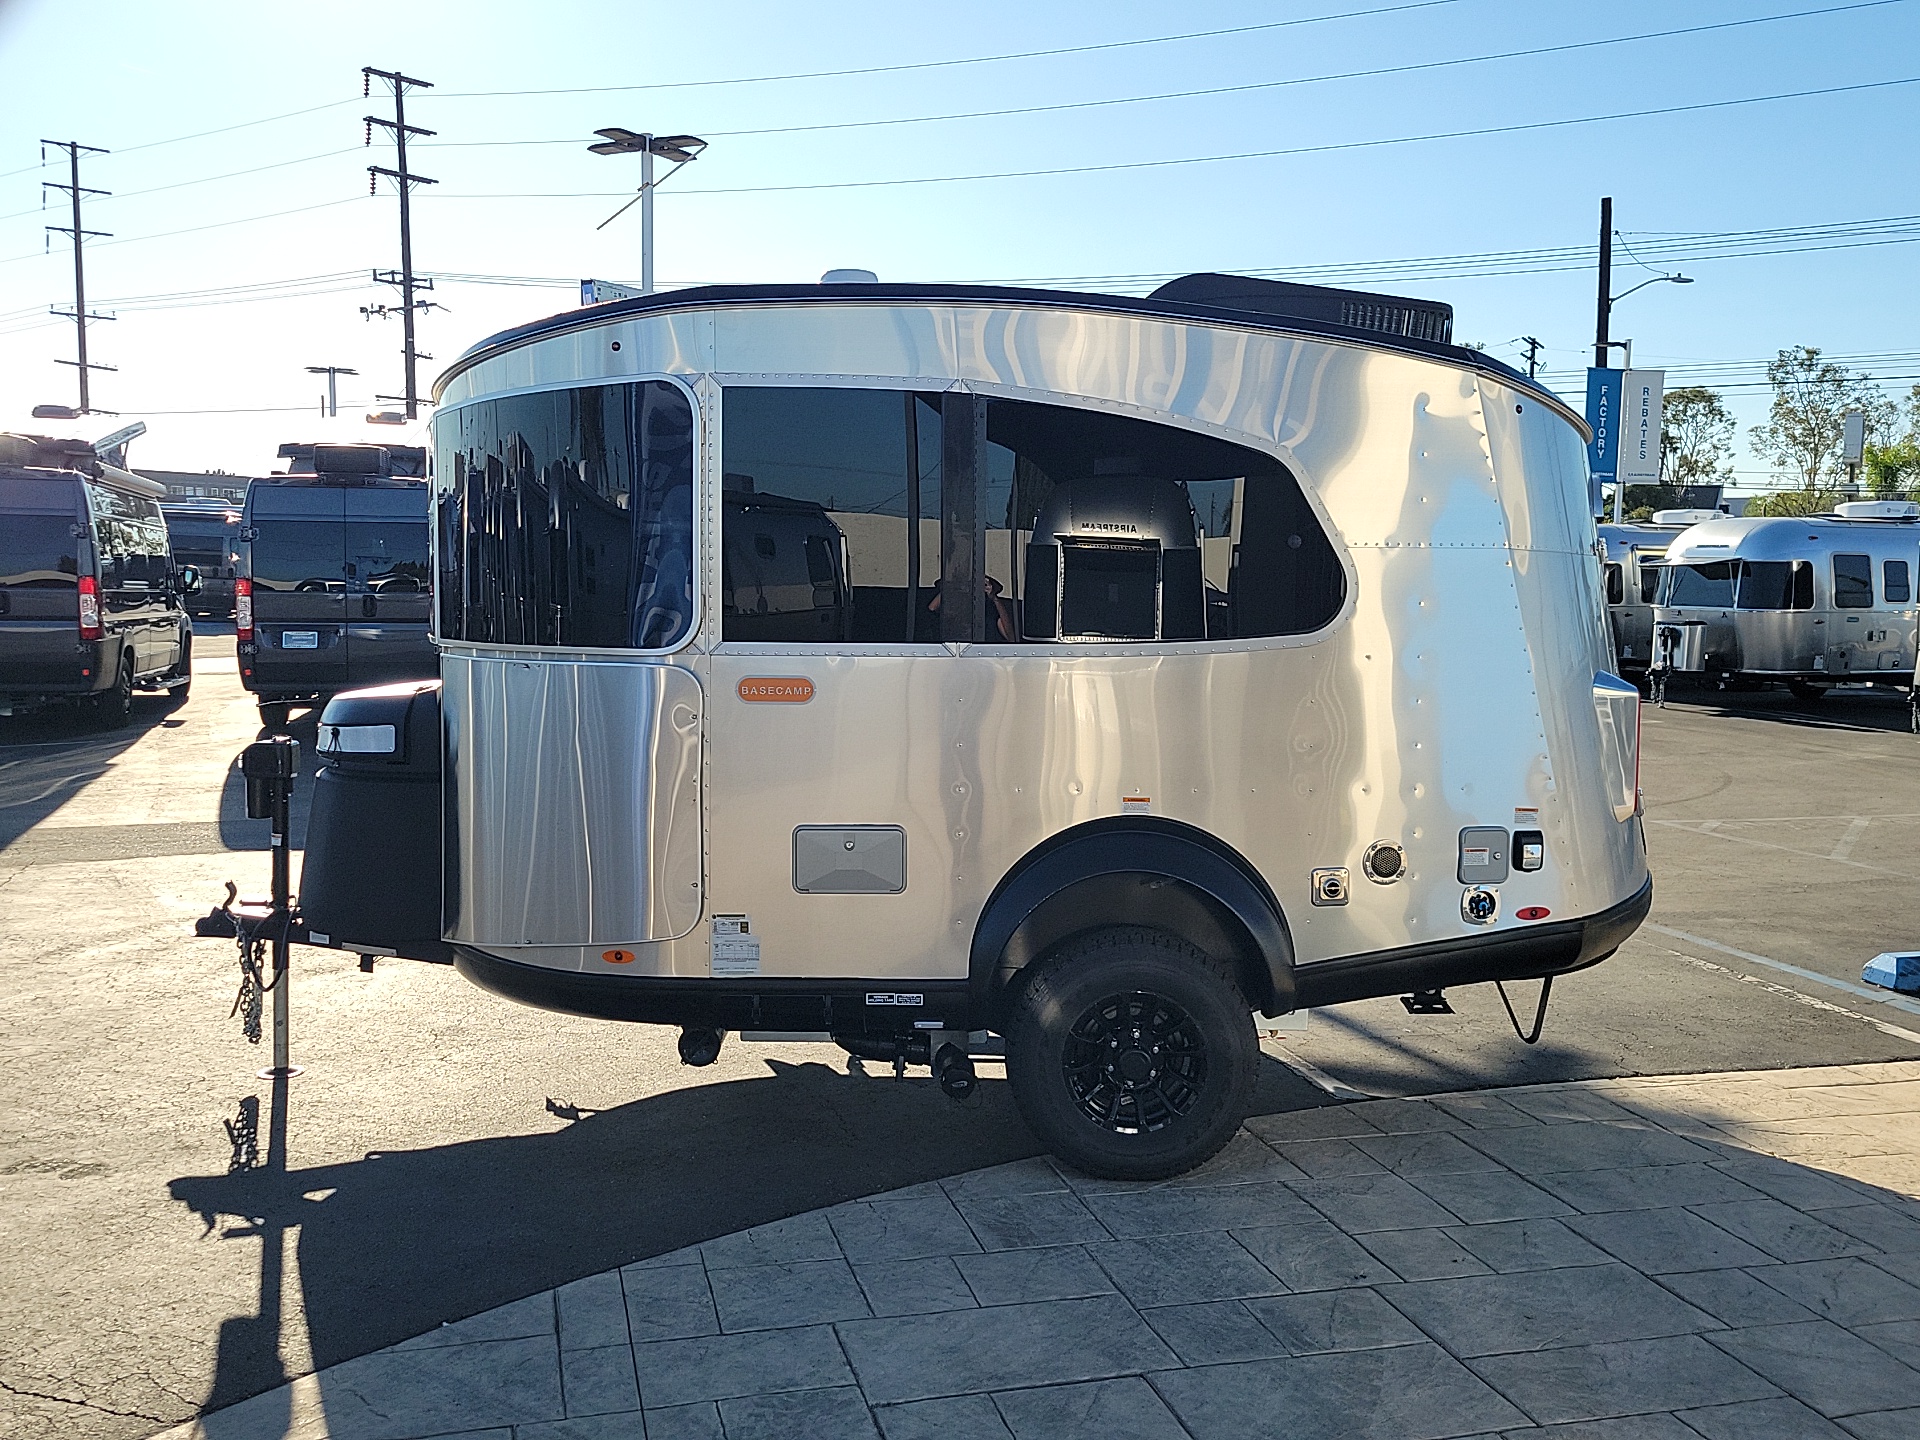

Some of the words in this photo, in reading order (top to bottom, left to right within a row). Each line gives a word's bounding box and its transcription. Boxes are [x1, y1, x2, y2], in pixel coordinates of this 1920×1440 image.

[1597, 385, 1609, 459] FACTORY
[1639, 386, 1650, 460] REBATES
[741, 686, 811, 695] BASECAMP
